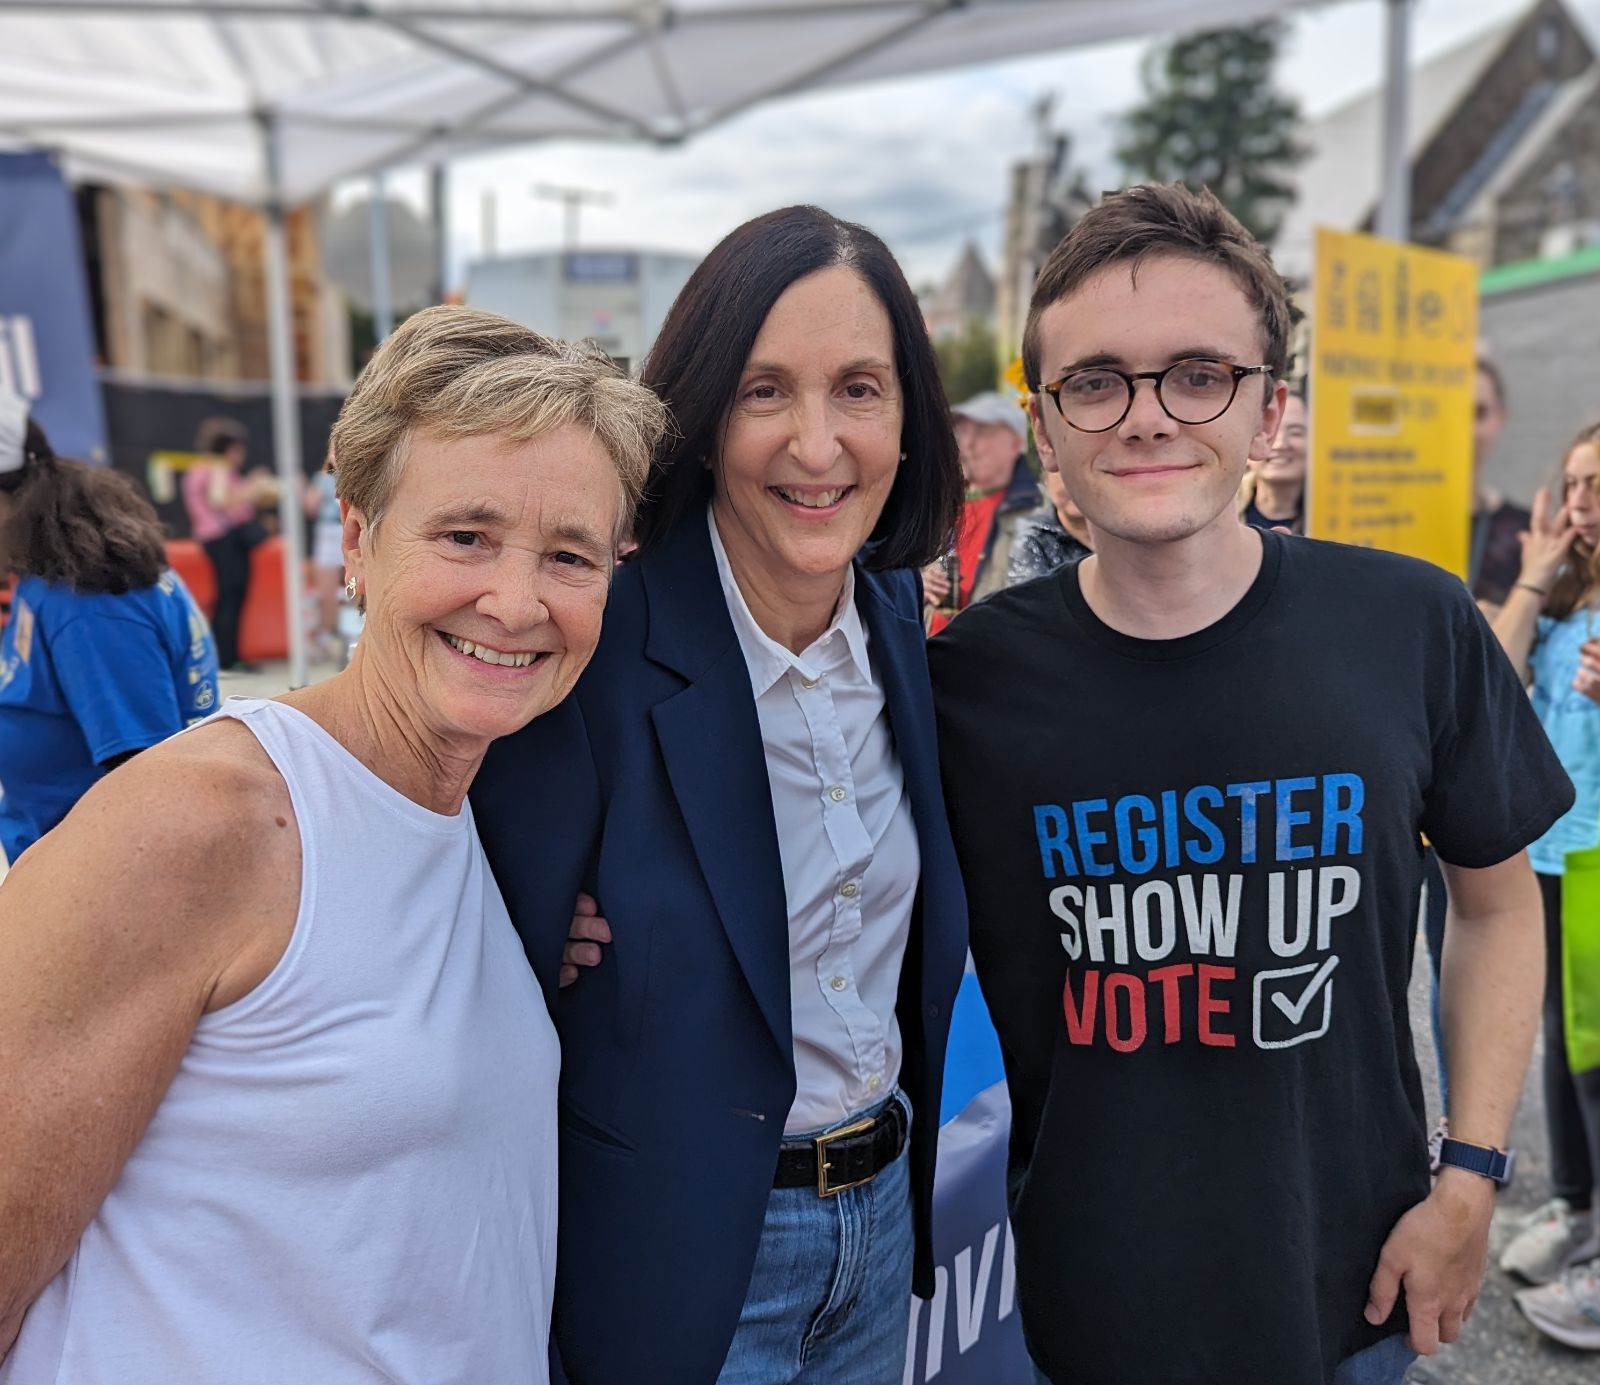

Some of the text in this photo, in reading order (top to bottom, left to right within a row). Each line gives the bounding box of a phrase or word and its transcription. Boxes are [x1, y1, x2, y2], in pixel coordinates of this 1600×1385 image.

[1033, 772, 1365, 878] REGISTER
[1049, 865, 1361, 964] SHOW UP
[1063, 963, 1236, 1053] VOTE
